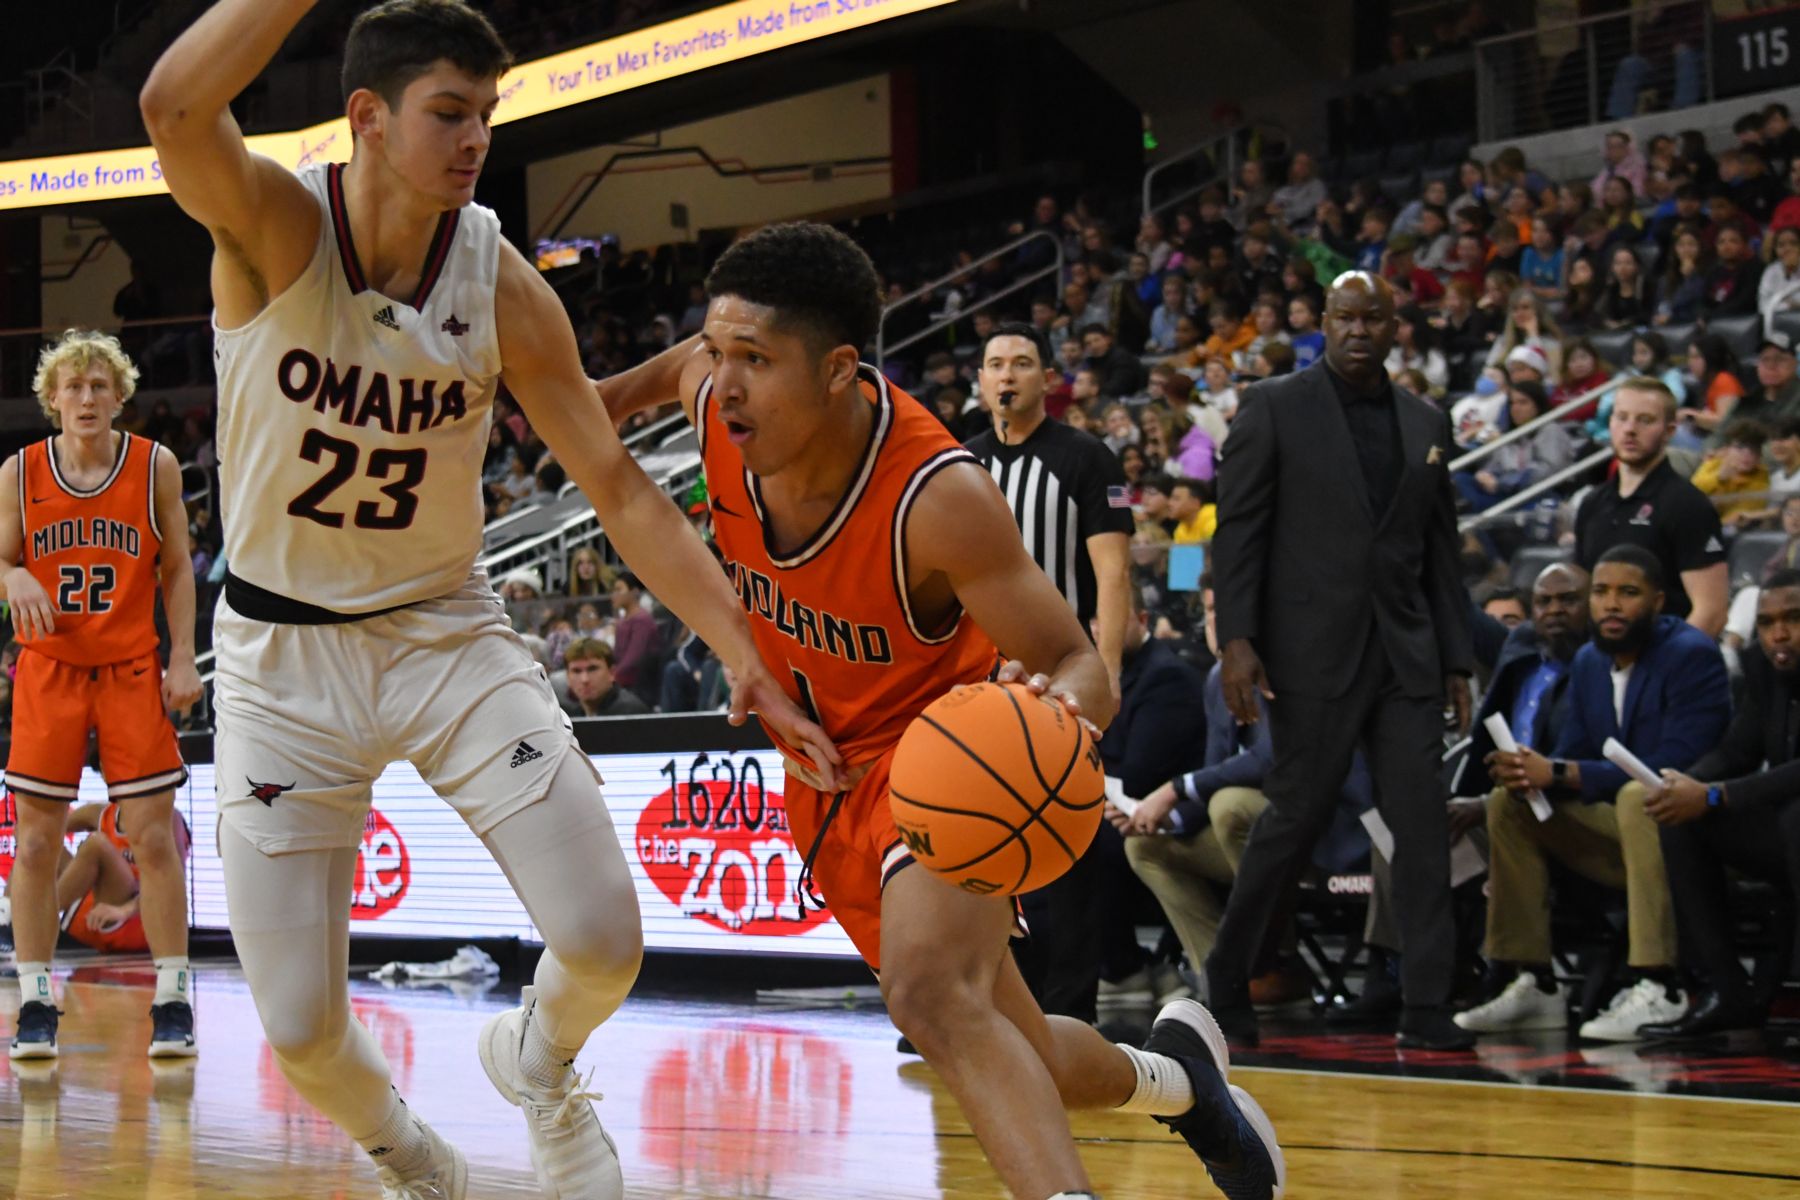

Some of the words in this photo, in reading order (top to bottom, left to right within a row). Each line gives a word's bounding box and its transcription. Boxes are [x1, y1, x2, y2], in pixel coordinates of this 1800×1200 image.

[547, 70, 582, 93] Your
[586, 60, 612, 84] Tex
[617, 51, 648, 75] Mex
[737, 10, 785, 41] Made
[1737, 26, 1790, 71] 115
[30, 169, 89, 193] Made
[94, 165, 145, 186] from
[278, 348, 467, 434] OMAHA
[286, 428, 428, 530] 23
[32, 517, 140, 560] MIDLAND
[58, 564, 115, 614] 22
[510, 750, 544, 769] adidas
[660, 752, 765, 832] 1620
[639, 833, 680, 864] the
